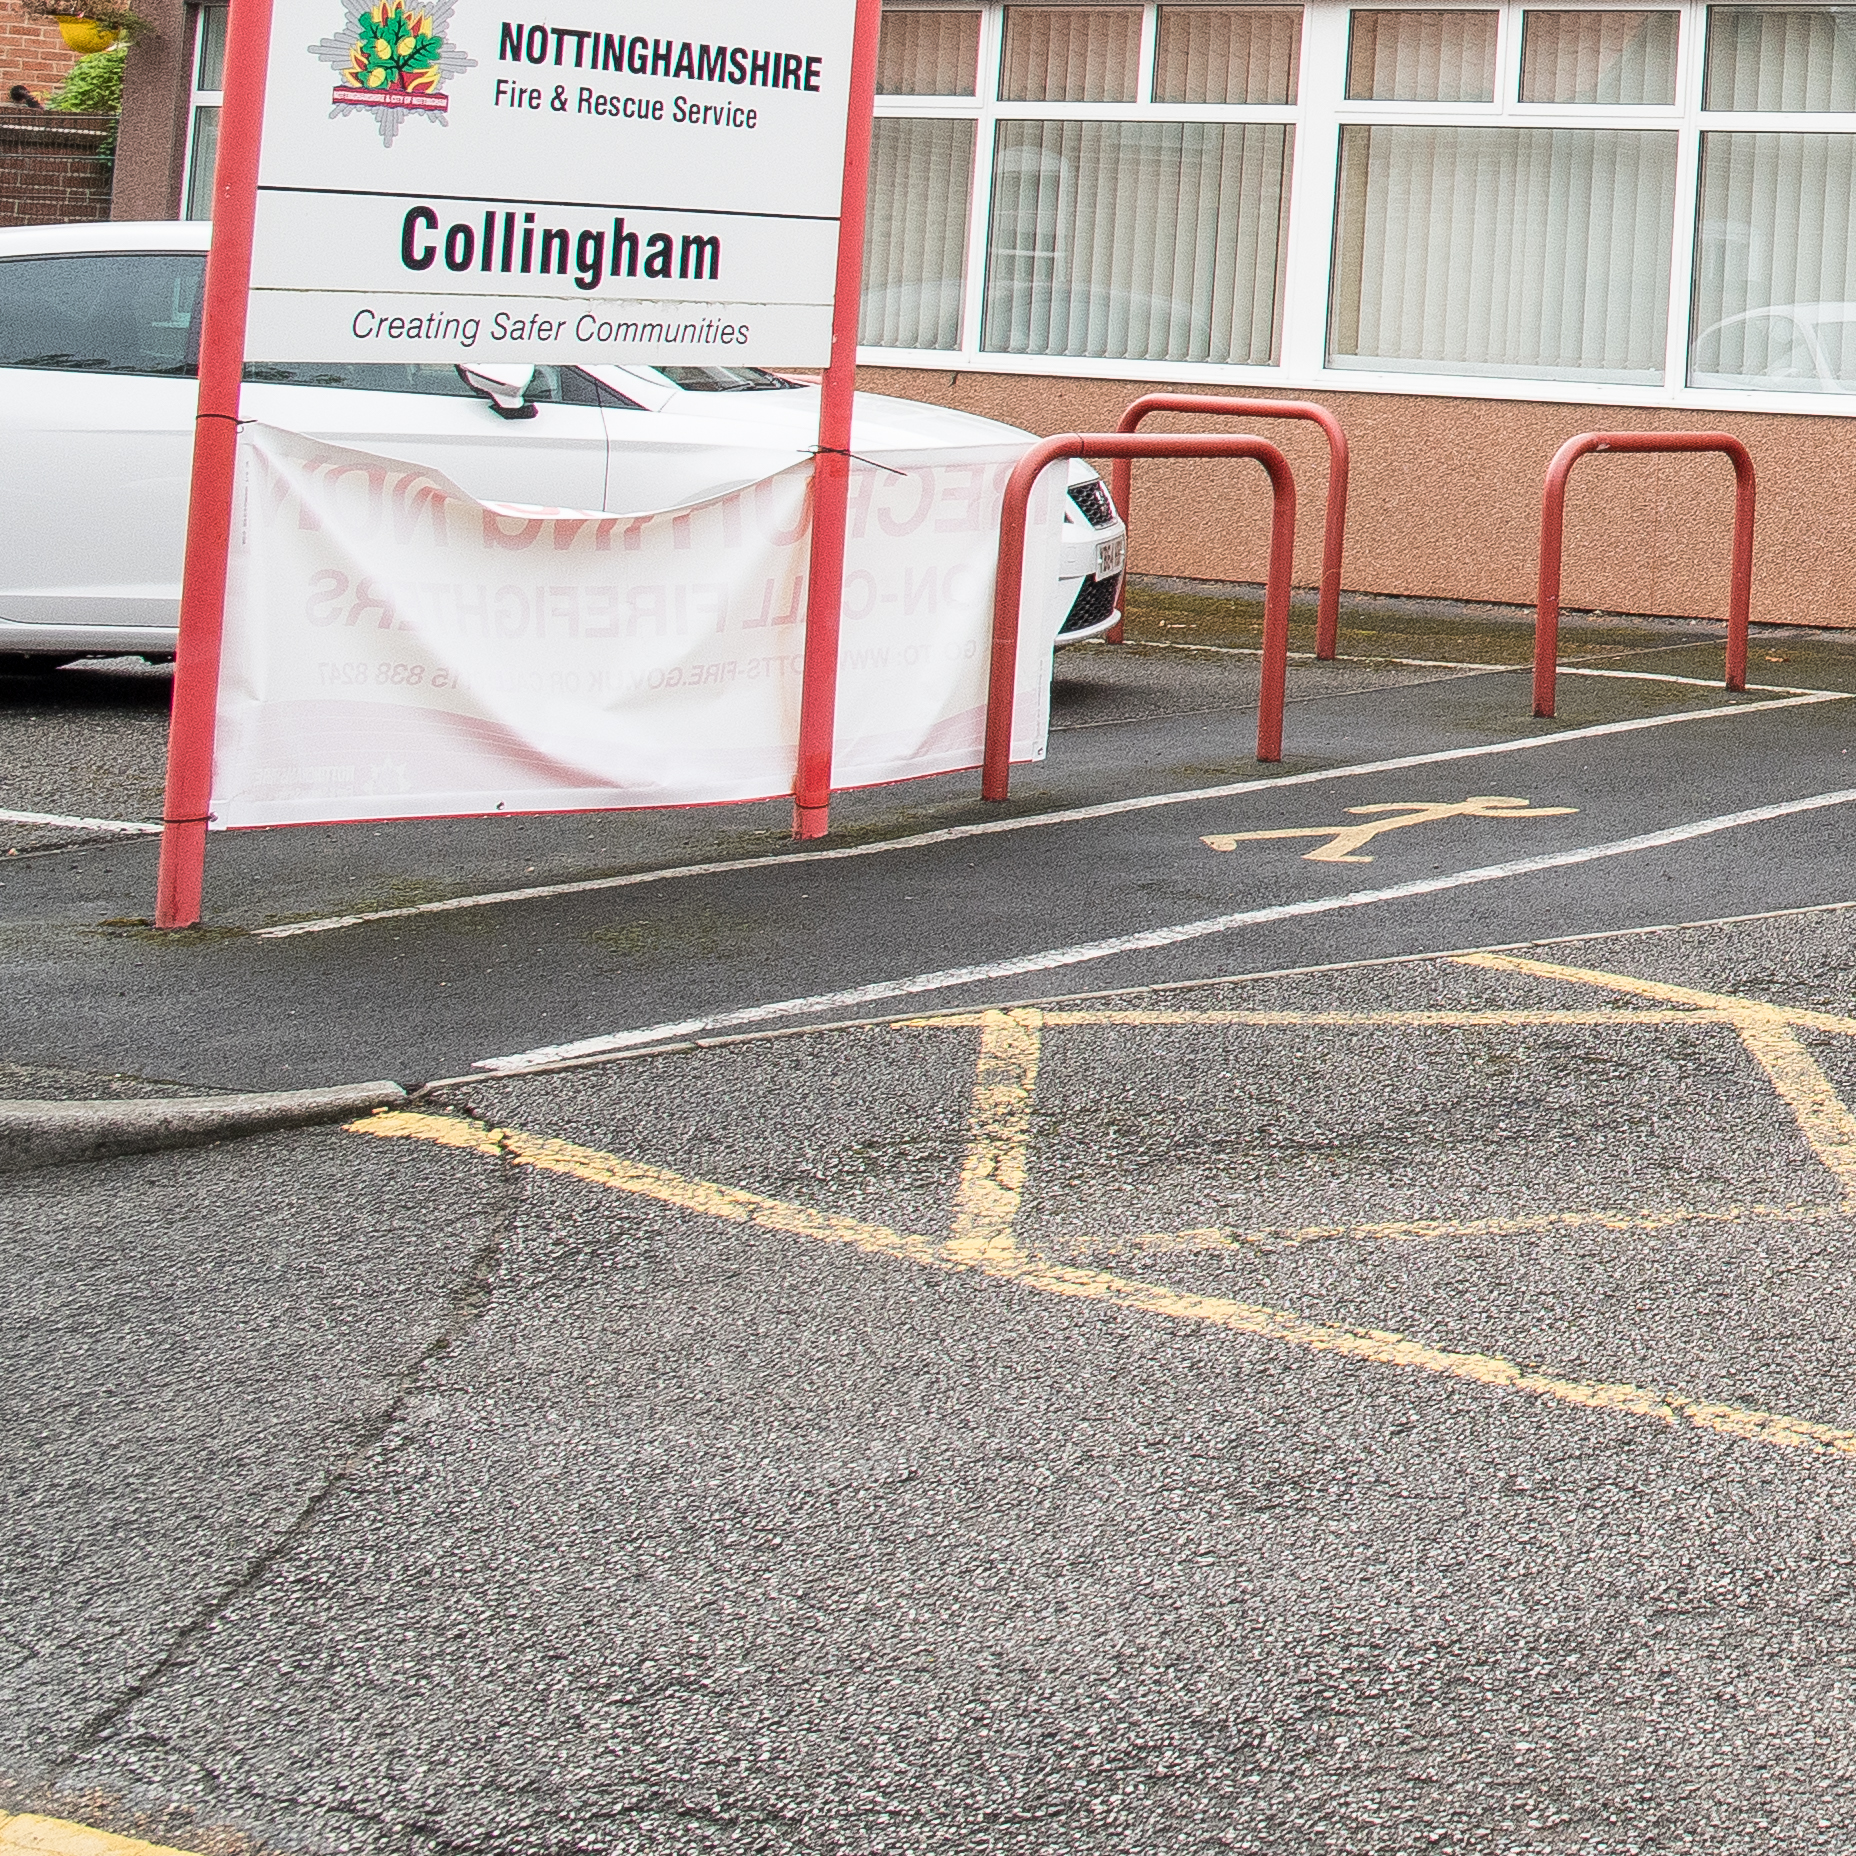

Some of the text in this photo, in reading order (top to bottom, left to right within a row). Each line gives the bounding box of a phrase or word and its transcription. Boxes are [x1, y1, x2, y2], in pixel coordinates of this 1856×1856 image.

[498, 22, 823, 93] NOTTINGHAMSHIRE
[494, 78, 758, 129] Fire & Rescue Service
[401, 205, 722, 291] Collingham
[352, 309, 750, 348] Creating Safer Communities
